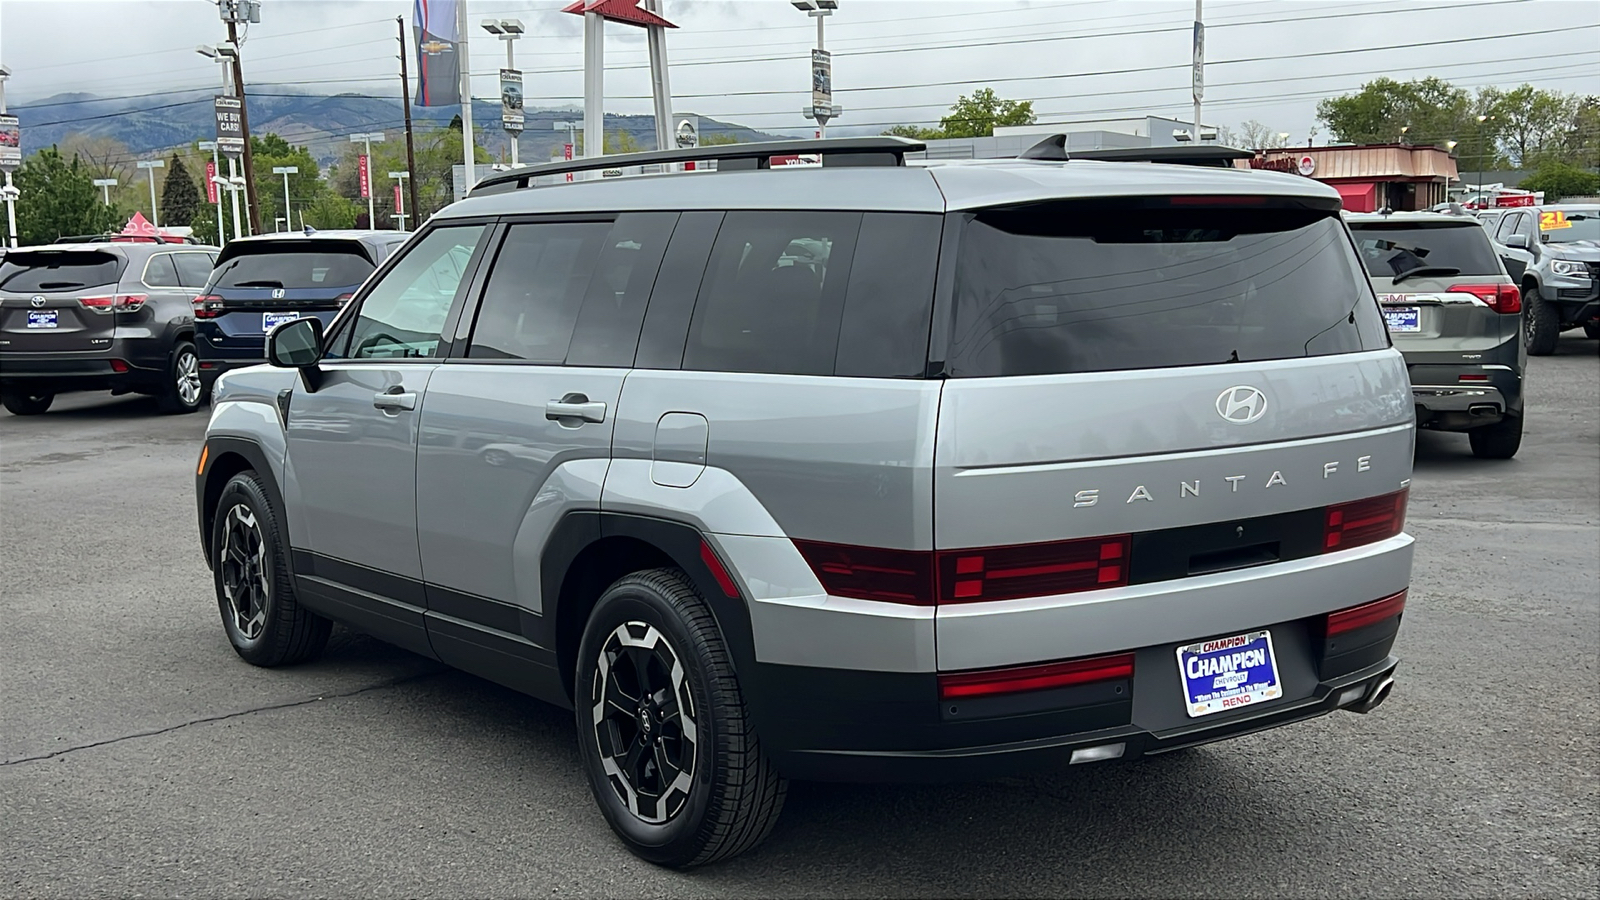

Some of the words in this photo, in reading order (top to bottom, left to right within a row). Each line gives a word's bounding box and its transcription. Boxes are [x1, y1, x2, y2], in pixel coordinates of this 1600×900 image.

[216, 112, 229, 121] WE
[229, 112, 241, 122] BUY
[1541, 211, 1564, 224] 21
[1377, 294, 1416, 303] GMC
[1073, 470, 1288, 509] SANTA
[1323, 455, 1371, 479] FE
[1203, 636, 1247, 653] CHAMPION
[1186, 648, 1266, 680] CHAMPION
[1215, 673, 1246, 686] CHEVROLET
[1222, 694, 1252, 709] RENO
